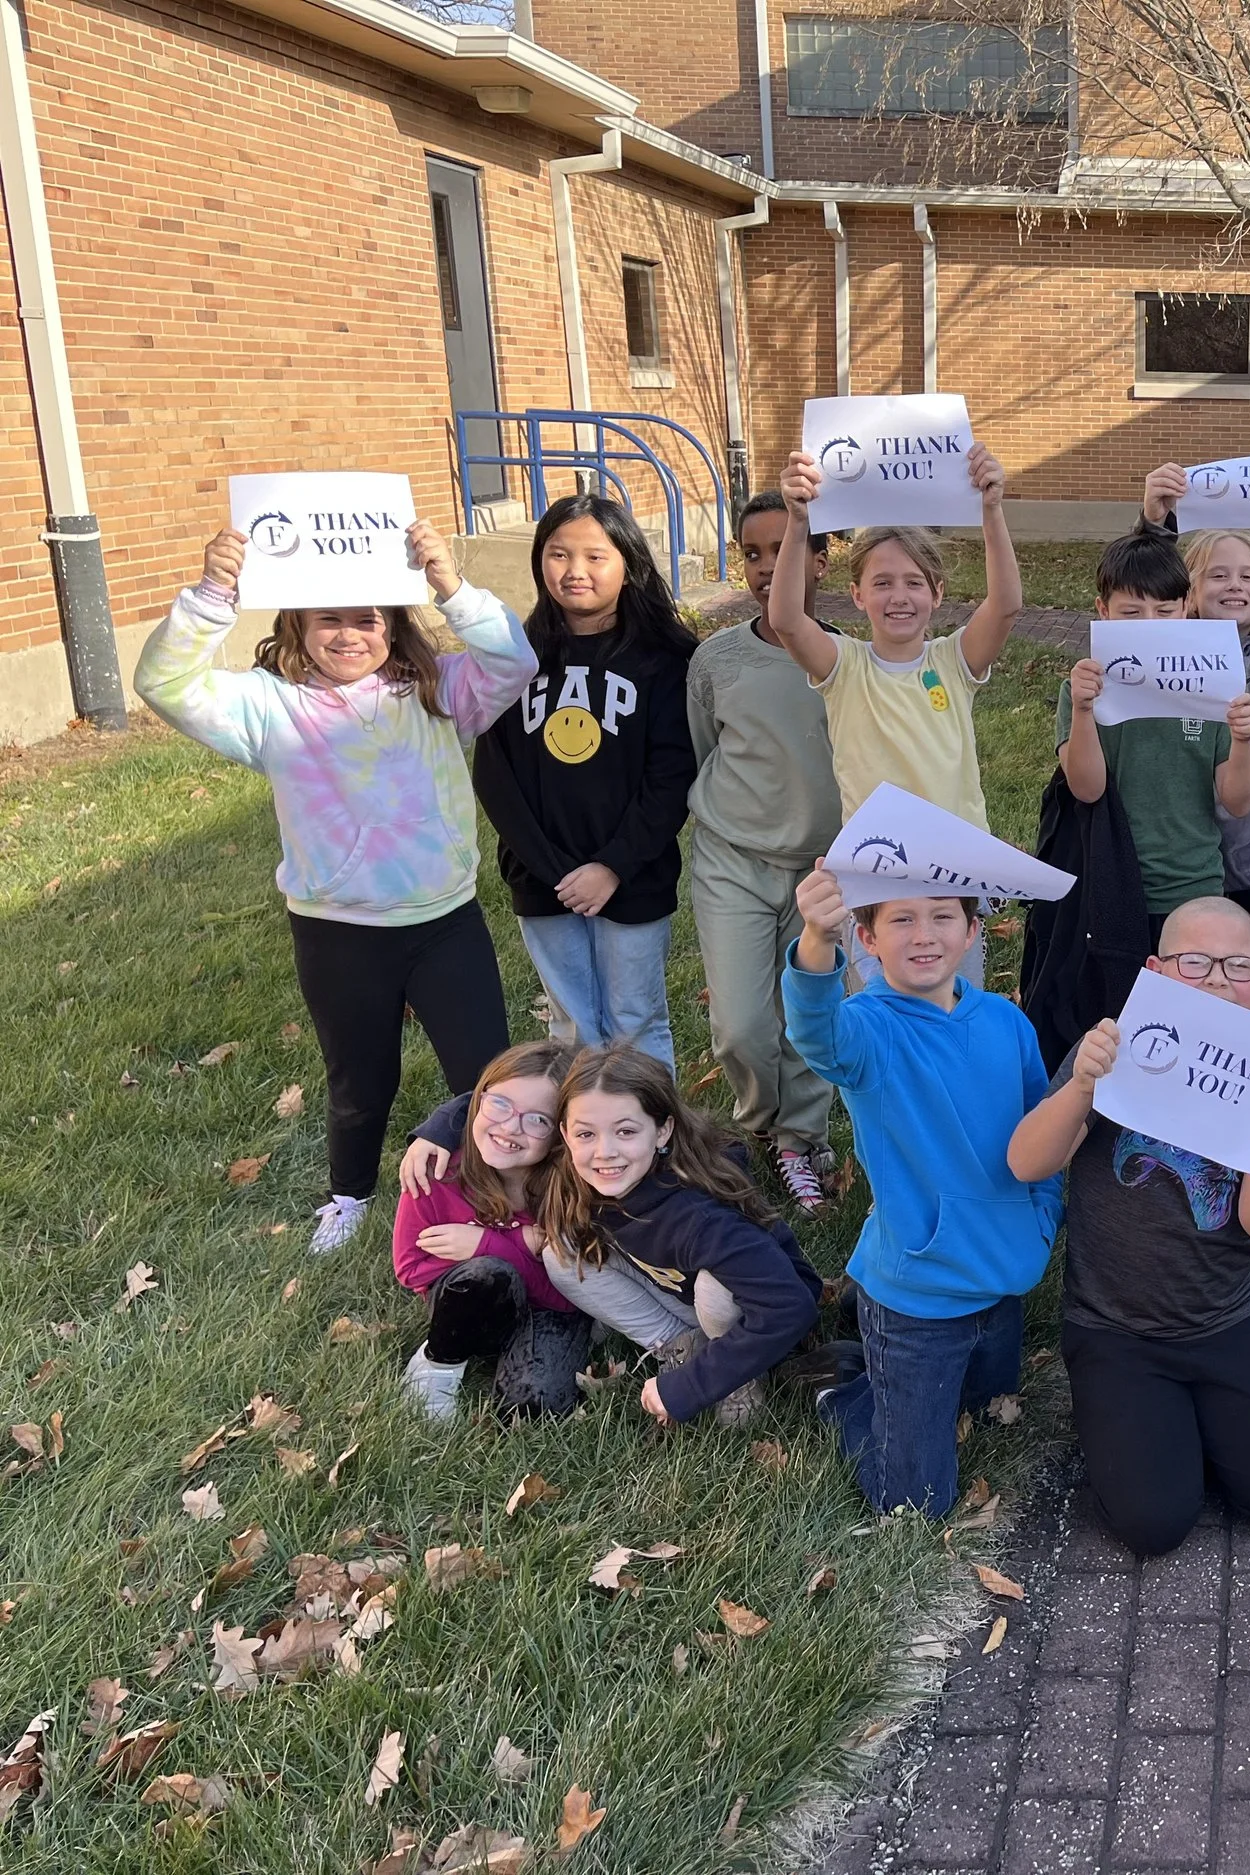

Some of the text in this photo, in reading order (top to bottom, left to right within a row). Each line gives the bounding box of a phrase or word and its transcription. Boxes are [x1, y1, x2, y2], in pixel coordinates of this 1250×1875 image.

[876, 435, 961, 456] THANK
[835, 450, 853, 472] F
[877, 460, 933, 481] YOU!
[1204, 472, 1219, 490] F
[308, 512, 400, 531] THANK
[266, 525, 285, 547] F
[311, 535, 372, 555] YOU!
[1120, 666, 1135, 680] F
[1156, 654, 1229, 673] THANK
[1155, 677, 1204, 693] YOU!
[521, 666, 638, 736] GAP
[1144, 1036, 1170, 1060] F
[1185, 1066, 1246, 1105] YOU!
